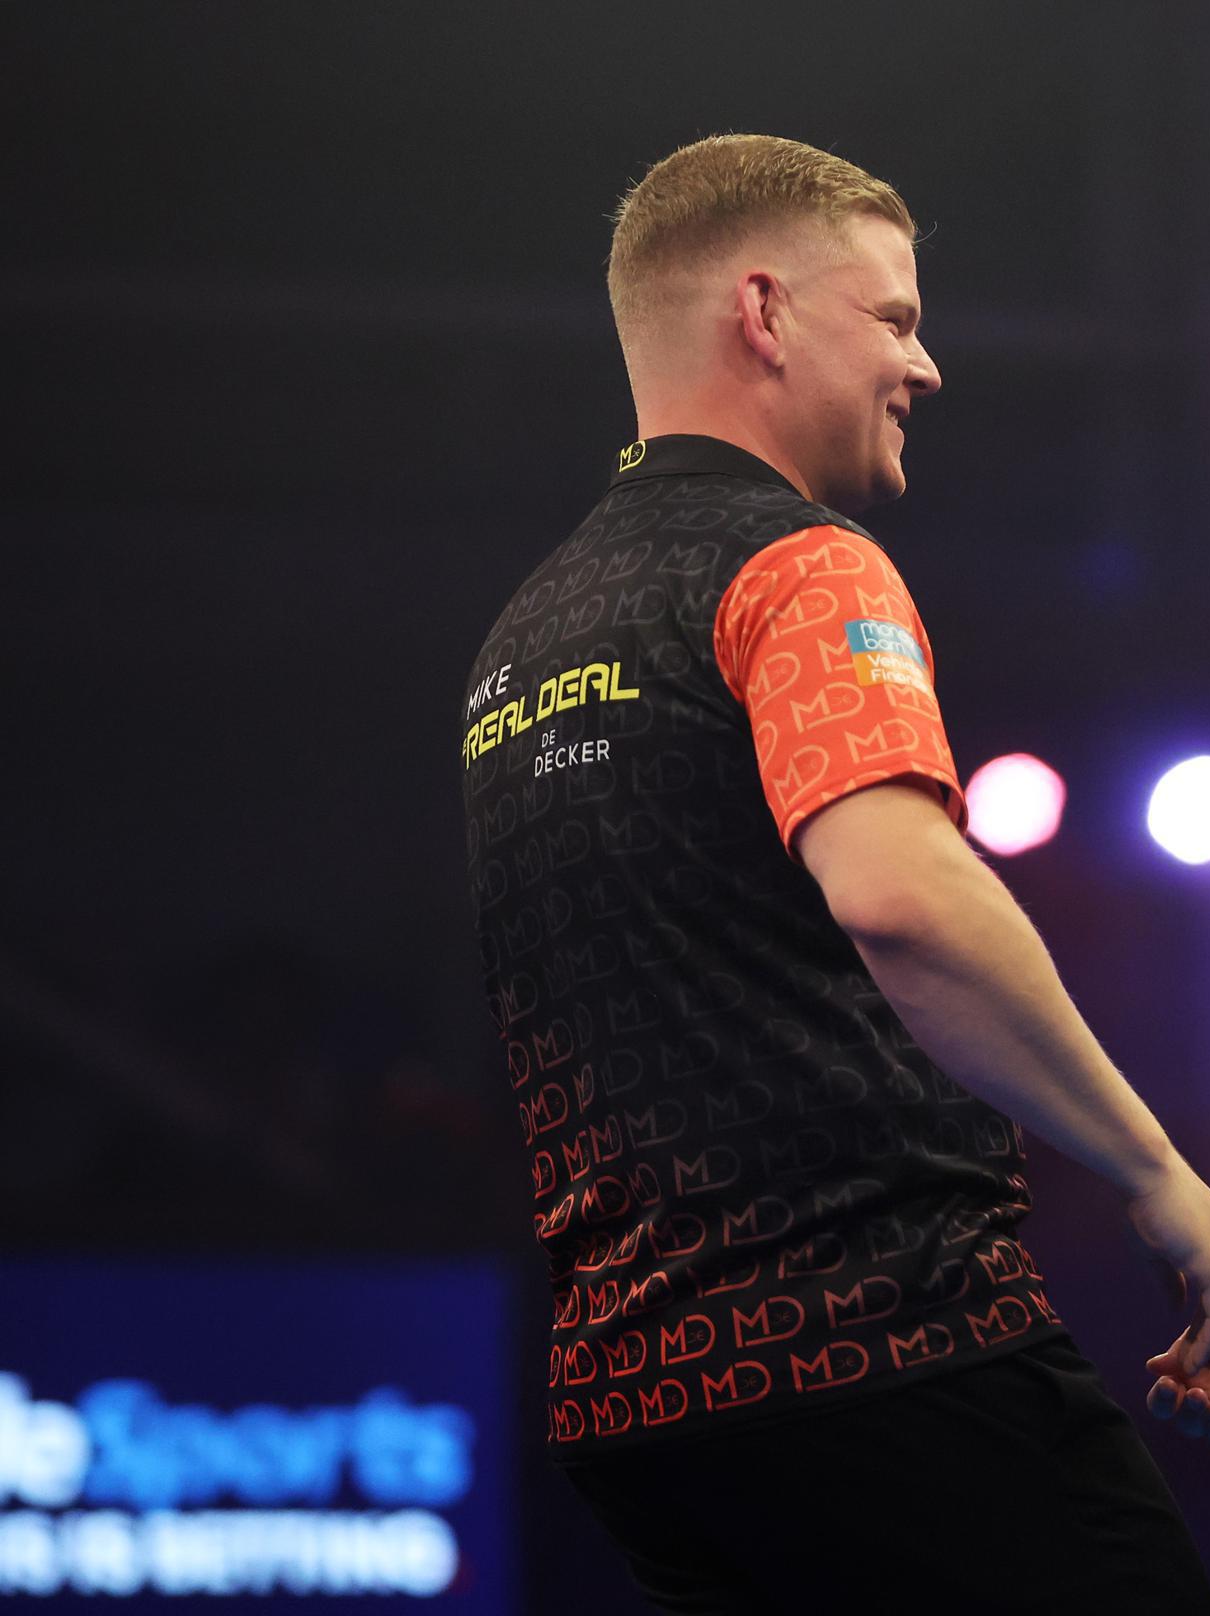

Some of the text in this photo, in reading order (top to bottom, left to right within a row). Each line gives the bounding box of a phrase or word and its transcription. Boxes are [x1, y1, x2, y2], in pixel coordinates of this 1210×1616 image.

[794, 542, 866, 578] MD
[467, 664, 512, 721] MIKE
[870, 668, 929, 694] Finan
[466, 662, 640, 770] REAL DEAL
[790, 682, 865, 733] MD
[534, 739, 610, 777] DECKER
[541, 729, 556, 748] DE
[844, 718, 920, 764] MD
[772, 745, 830, 812] MD
[732, 1296, 806, 1348] MD
[824, 1275, 901, 1328] MD
[965, 1296, 1032, 1348] MD
[564, 1341, 597, 1385] MD
[600, 1330, 647, 1377] MD
[660, 1314, 716, 1366] MD
[887, 1323, 955, 1369] MD
[700, 1361, 772, 1412] MD
[790, 1341, 870, 1393] MD
[555, 1400, 585, 1442] MD
[590, 1391, 632, 1437] MD
[638, 1378, 688, 1427] MD
